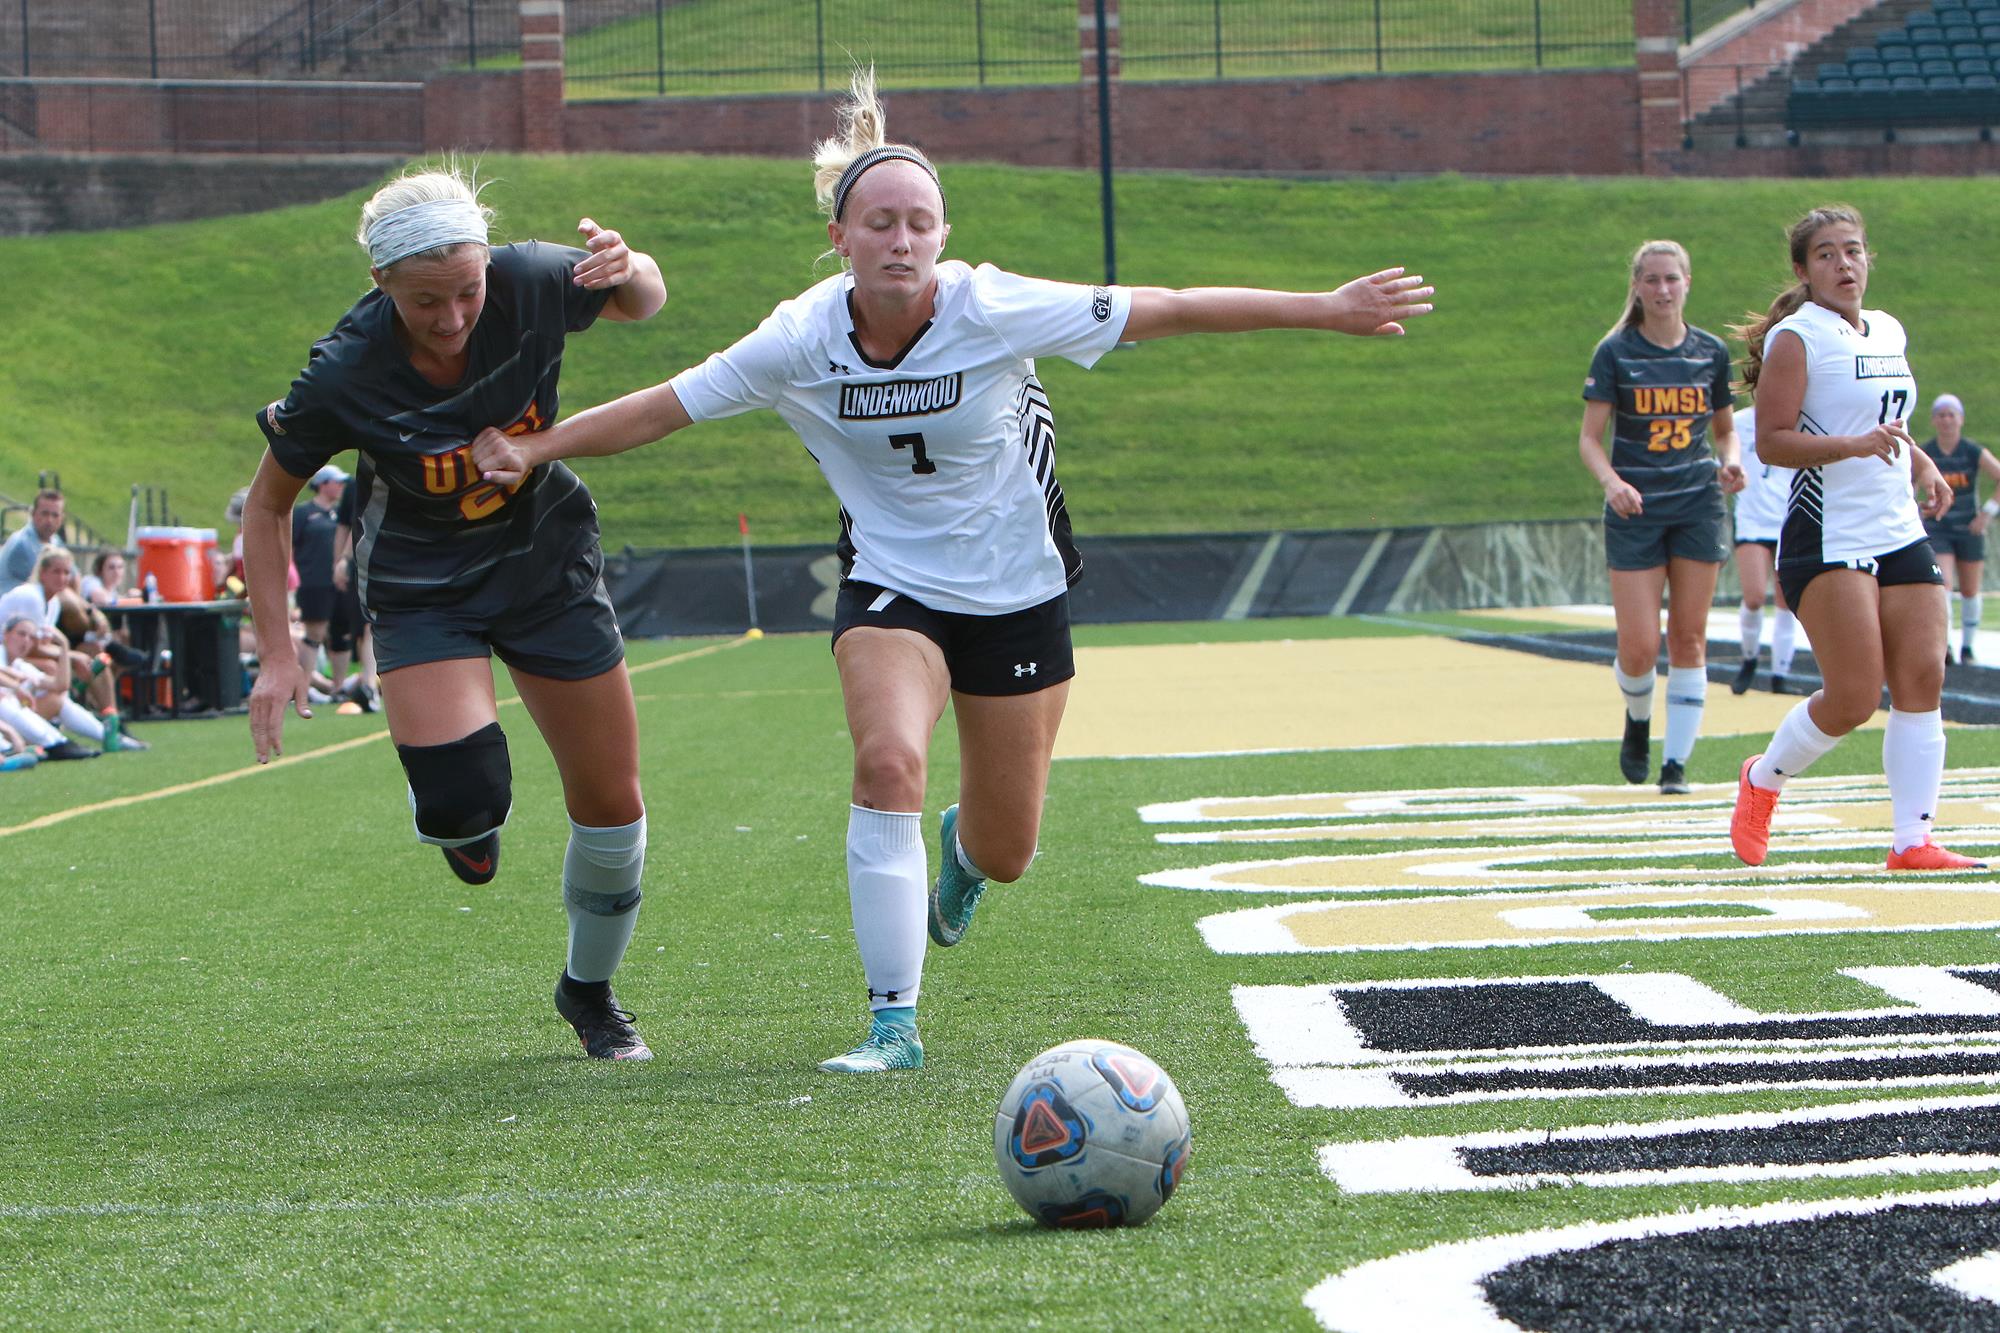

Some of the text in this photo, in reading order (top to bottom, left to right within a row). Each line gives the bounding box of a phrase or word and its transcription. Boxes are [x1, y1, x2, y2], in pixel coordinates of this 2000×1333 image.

[842, 373, 958, 416] LINDENWOOD
[1633, 386, 1709, 416] UMSL
[1879, 389, 1908, 425] 17
[1647, 418, 1695, 452] 25
[888, 432, 937, 475] 7
